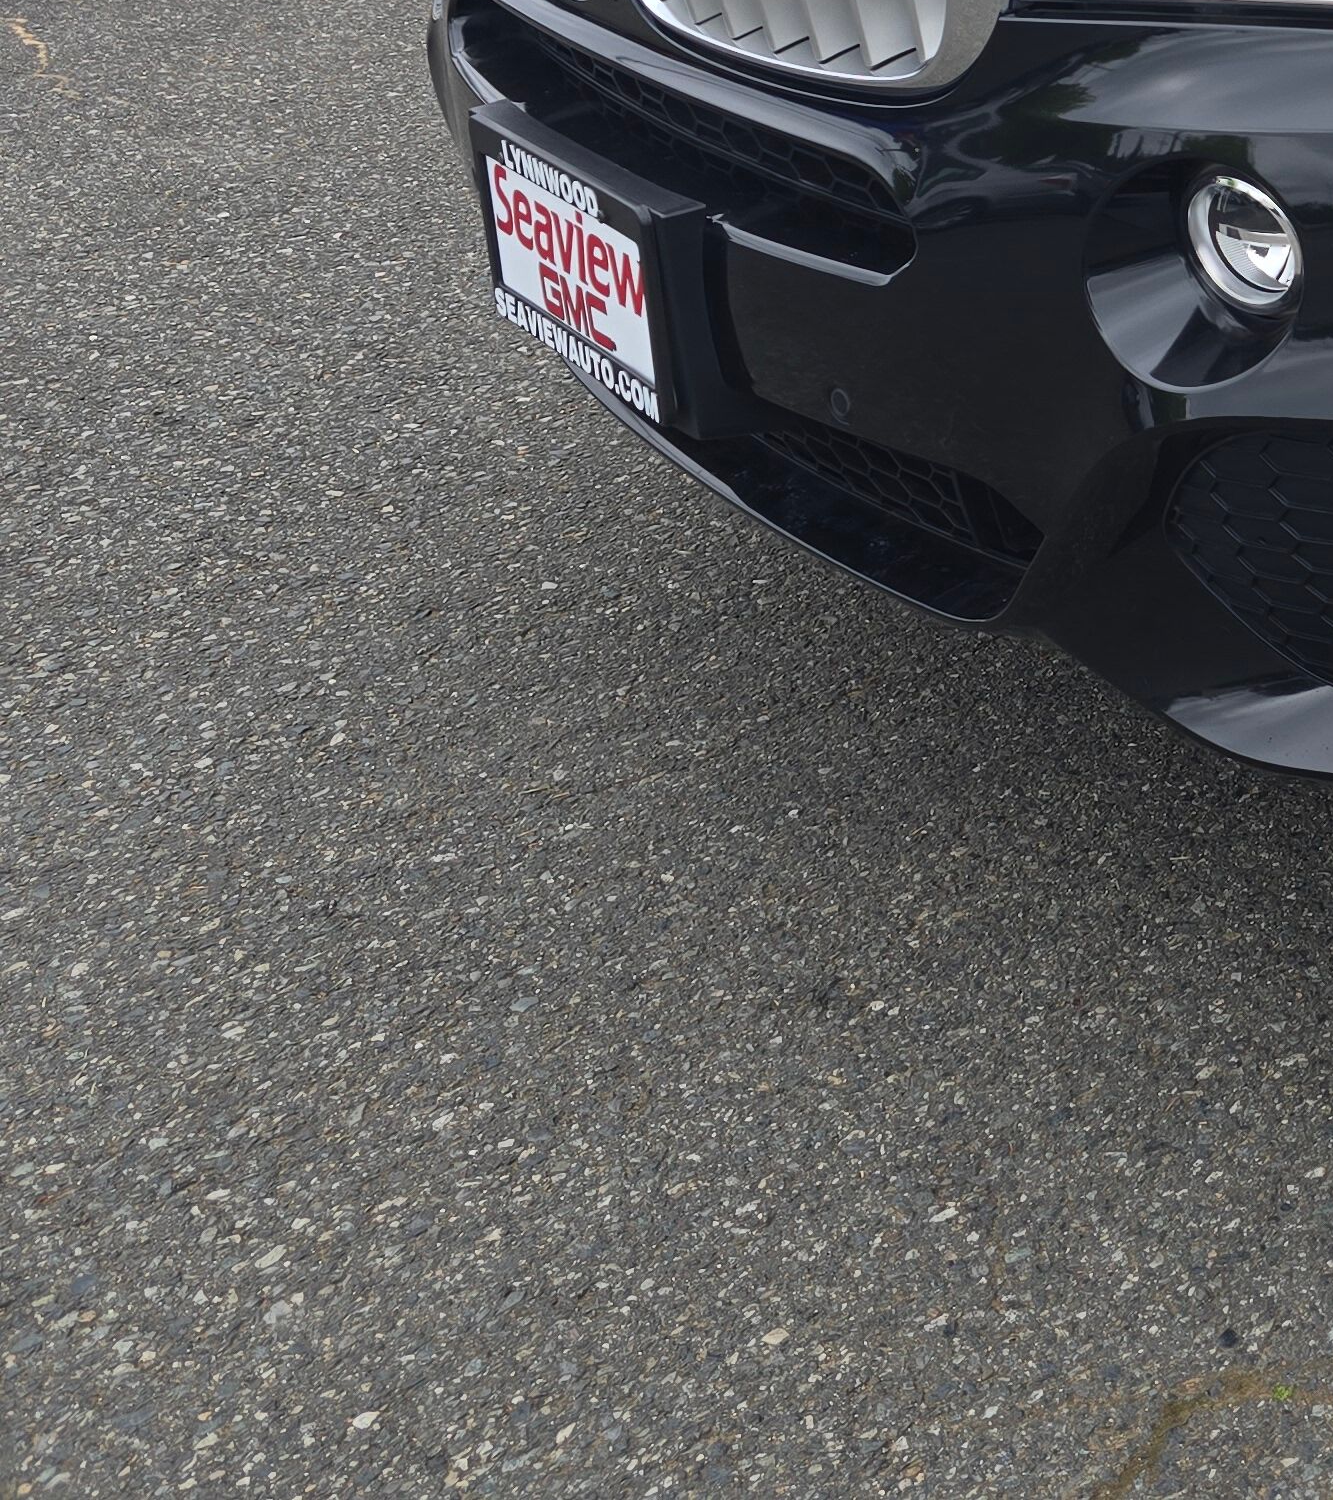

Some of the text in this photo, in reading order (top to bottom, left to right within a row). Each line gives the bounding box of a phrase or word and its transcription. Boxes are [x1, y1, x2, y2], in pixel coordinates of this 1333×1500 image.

[501, 138, 599, 217] LYNNWOOD
[493, 163, 645, 318] Seaview
[494, 286, 661, 424] SEAVIEWAUTO.COM
[538, 262, 617, 352] GMC
